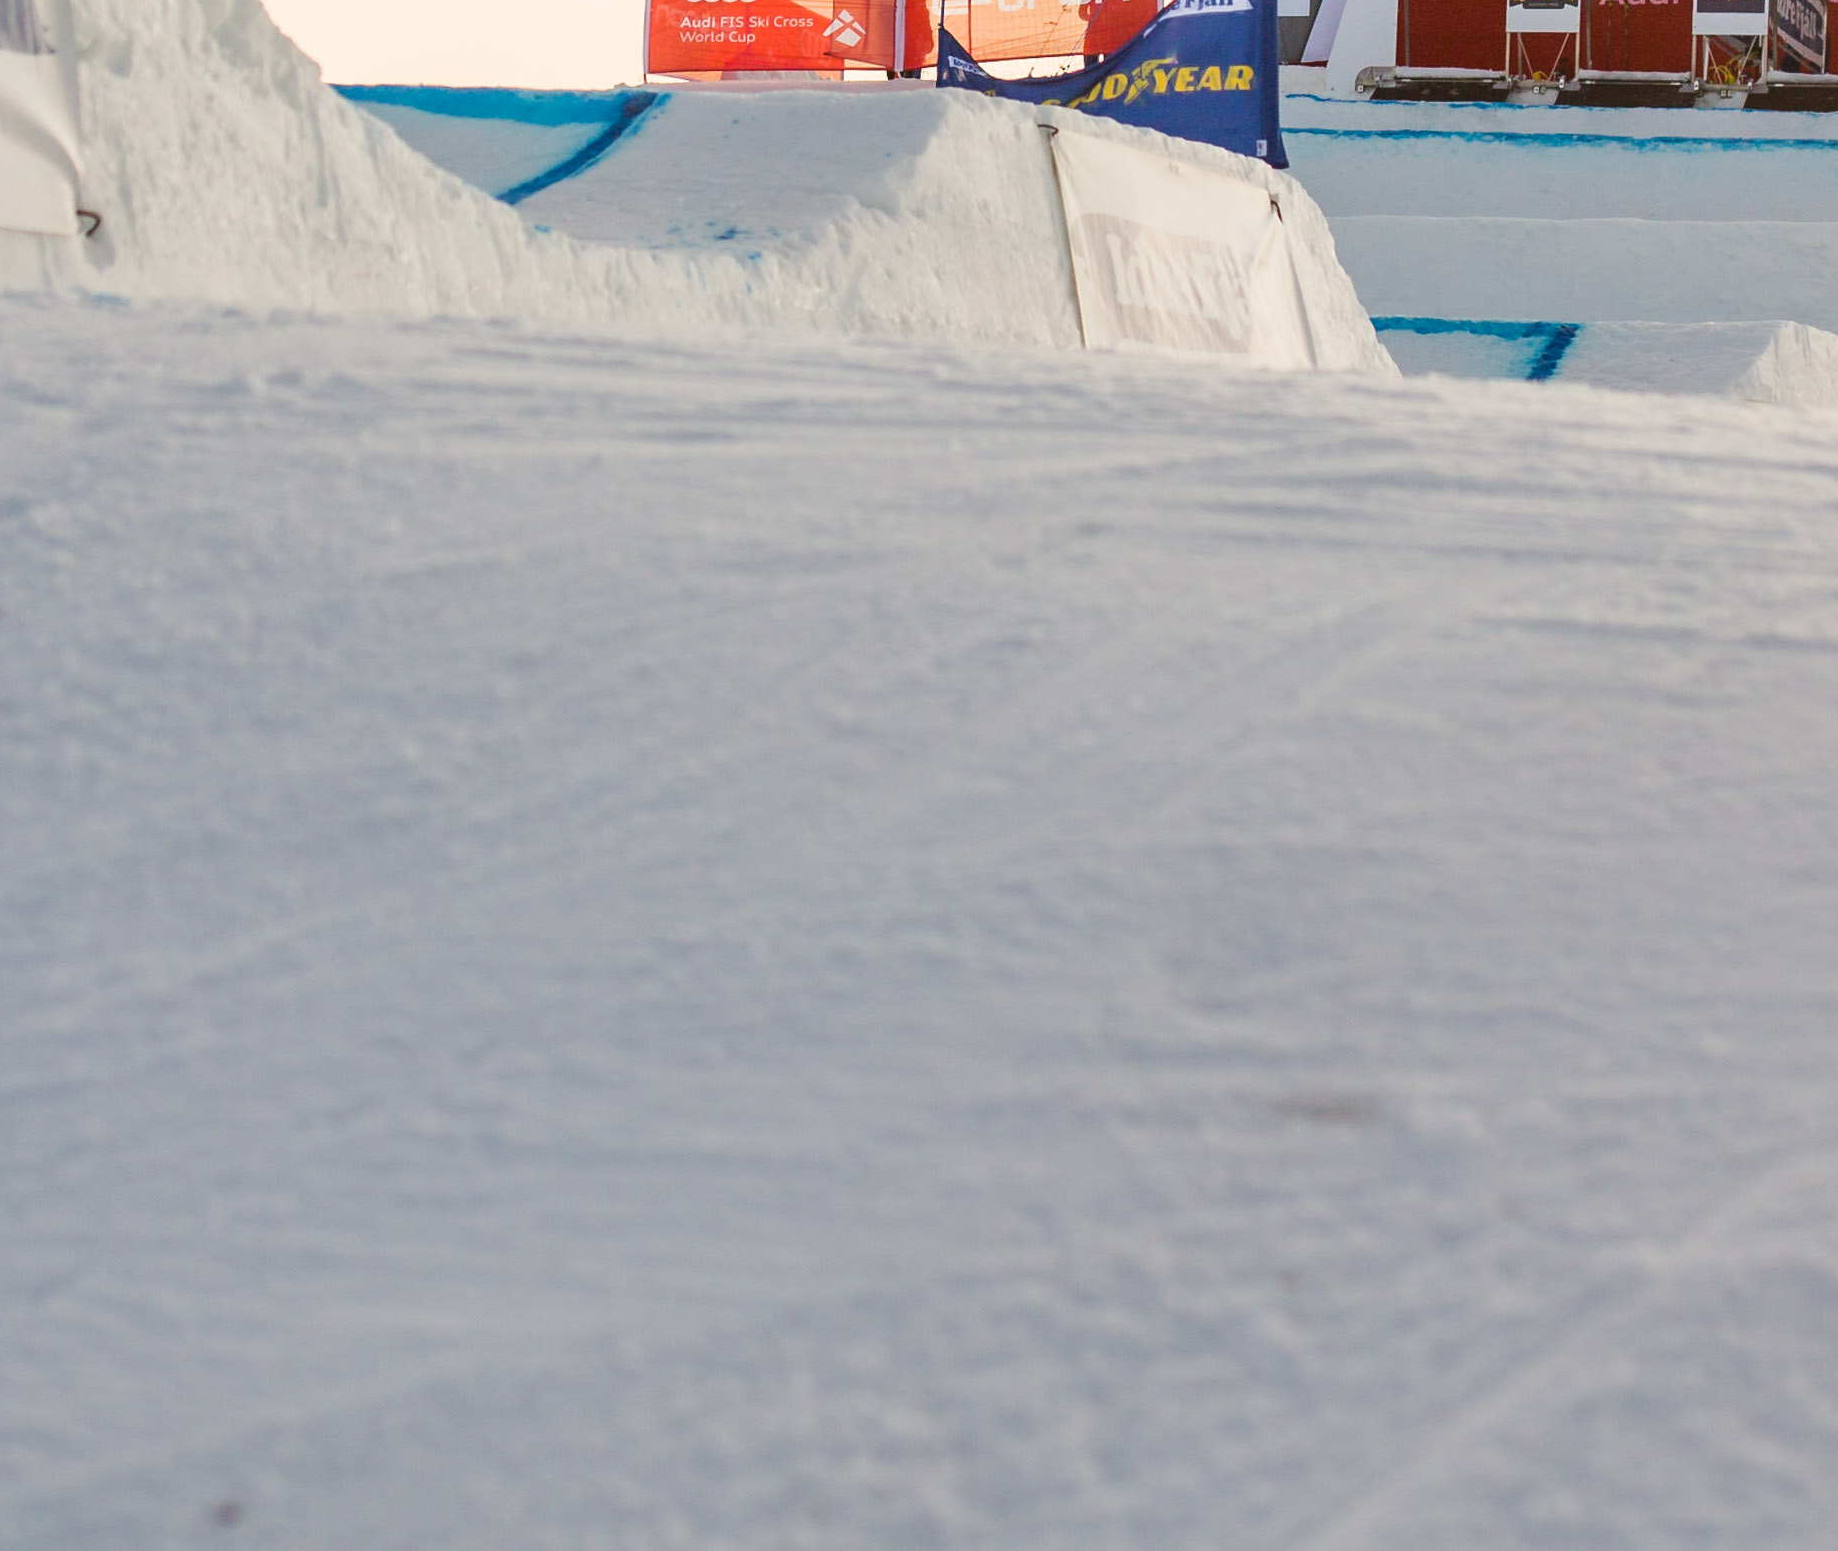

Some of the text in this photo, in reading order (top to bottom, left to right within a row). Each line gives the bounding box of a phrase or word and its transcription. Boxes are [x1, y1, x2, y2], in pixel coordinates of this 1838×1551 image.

[679, 15, 814, 29] Audi FIS Ski Cross
[679, 31, 756, 45] World Cup
